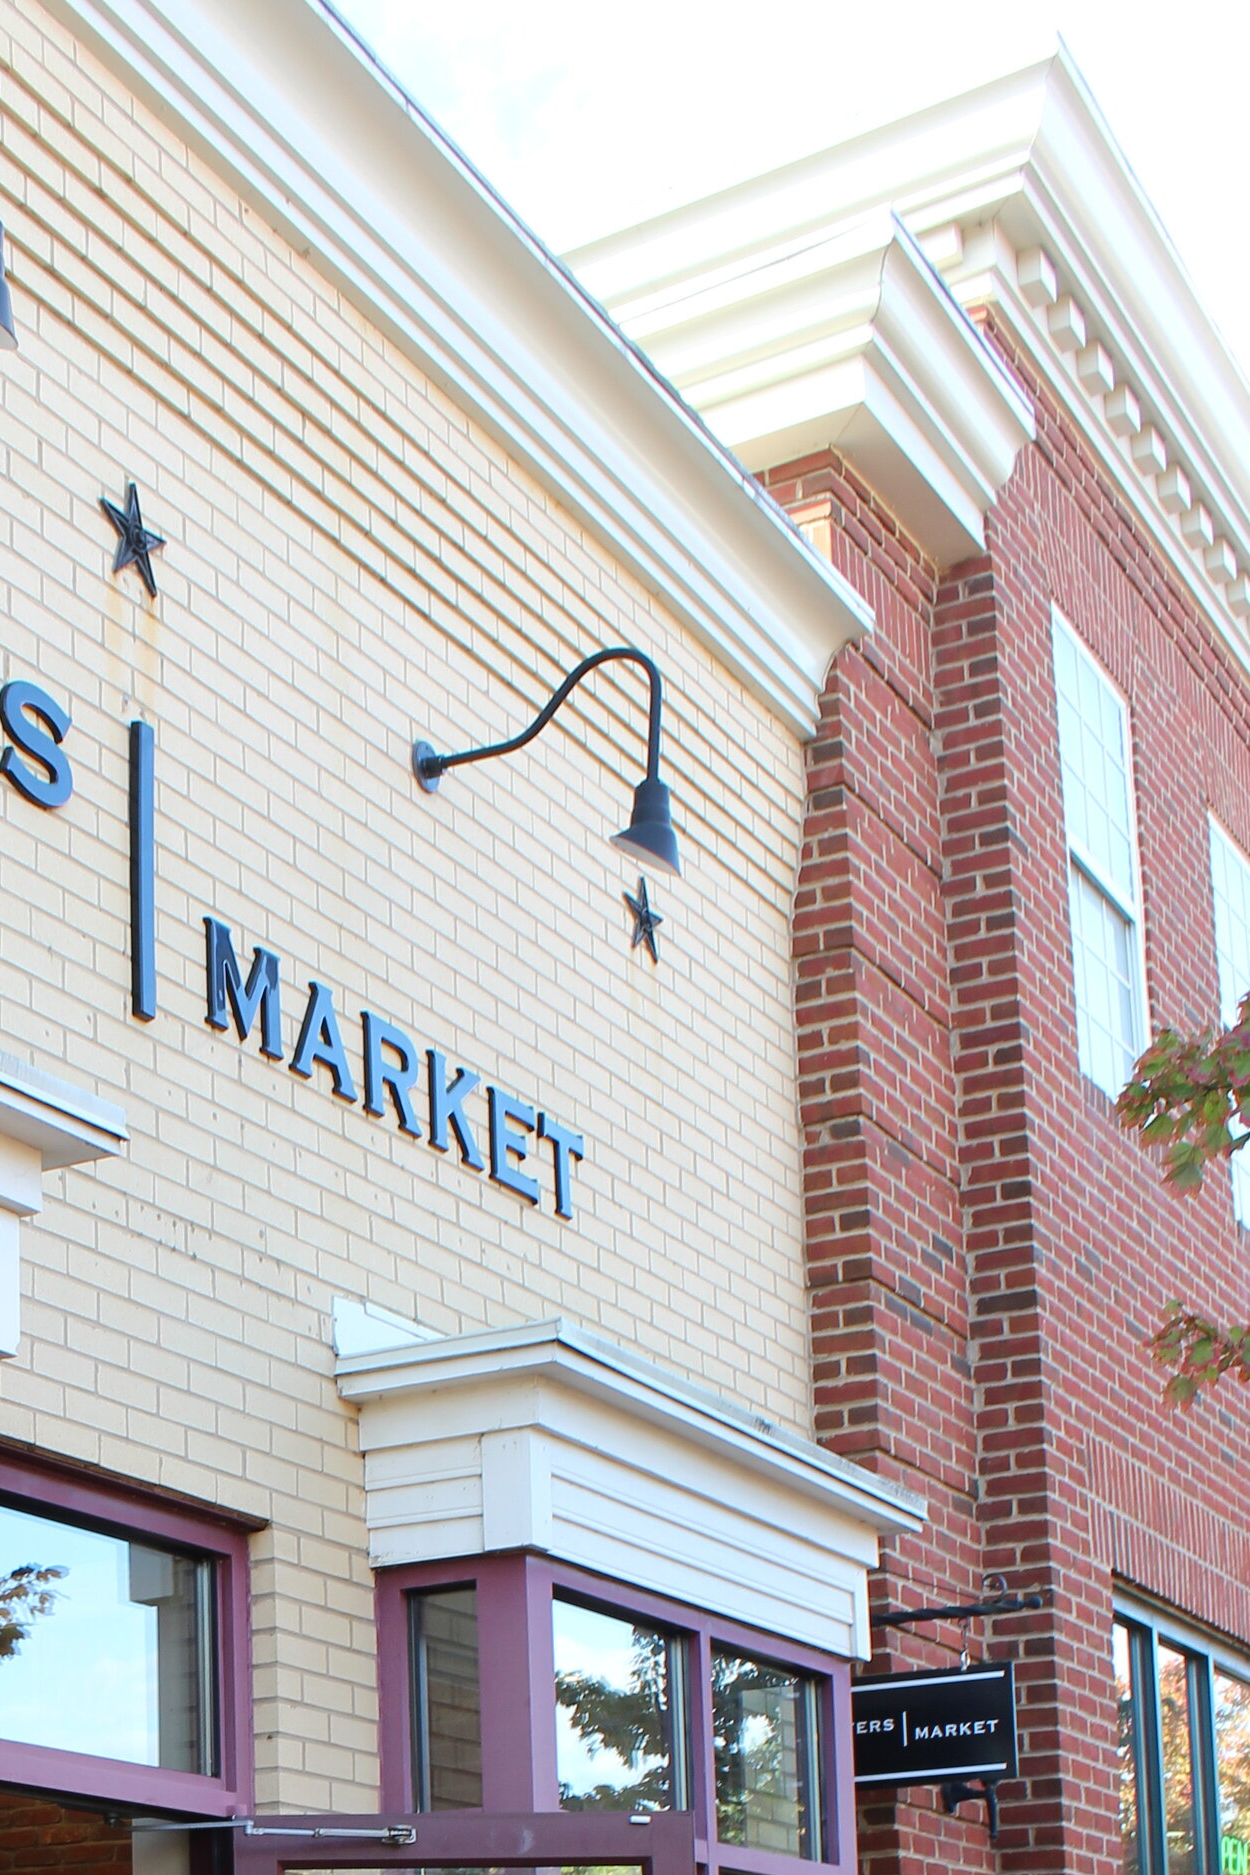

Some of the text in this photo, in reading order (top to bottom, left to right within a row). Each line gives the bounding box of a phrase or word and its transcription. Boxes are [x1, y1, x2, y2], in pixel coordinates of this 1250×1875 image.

[202, 915, 584, 1221] MARKET
[851, 1718, 1000, 1741] ERS MARKET
[1221, 1836, 1248, 1875] PEN
